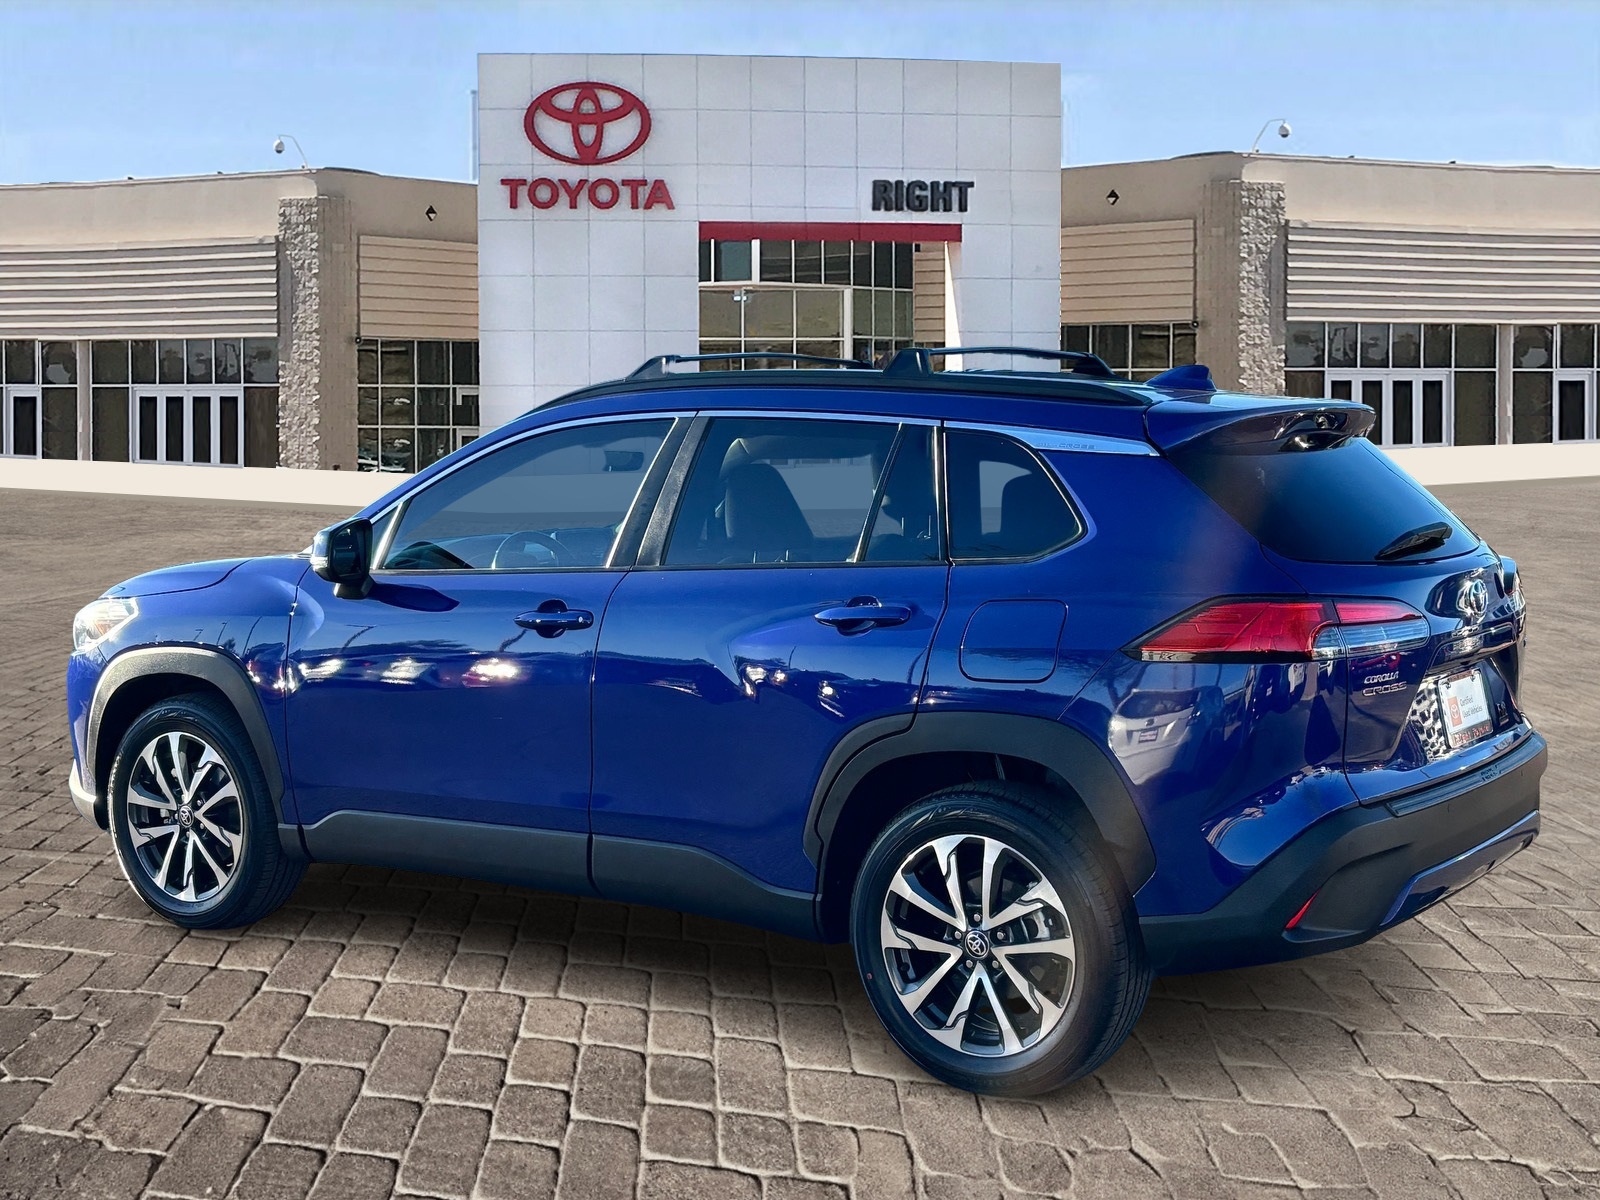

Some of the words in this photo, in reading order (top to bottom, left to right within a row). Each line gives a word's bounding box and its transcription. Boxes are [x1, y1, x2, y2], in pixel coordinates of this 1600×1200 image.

[500, 178, 675, 210] TOYOTA
[871, 179, 975, 213] RIGHT
[1363, 681, 1407, 697] CROSS
[1364, 671, 1399, 684] COROLLA
